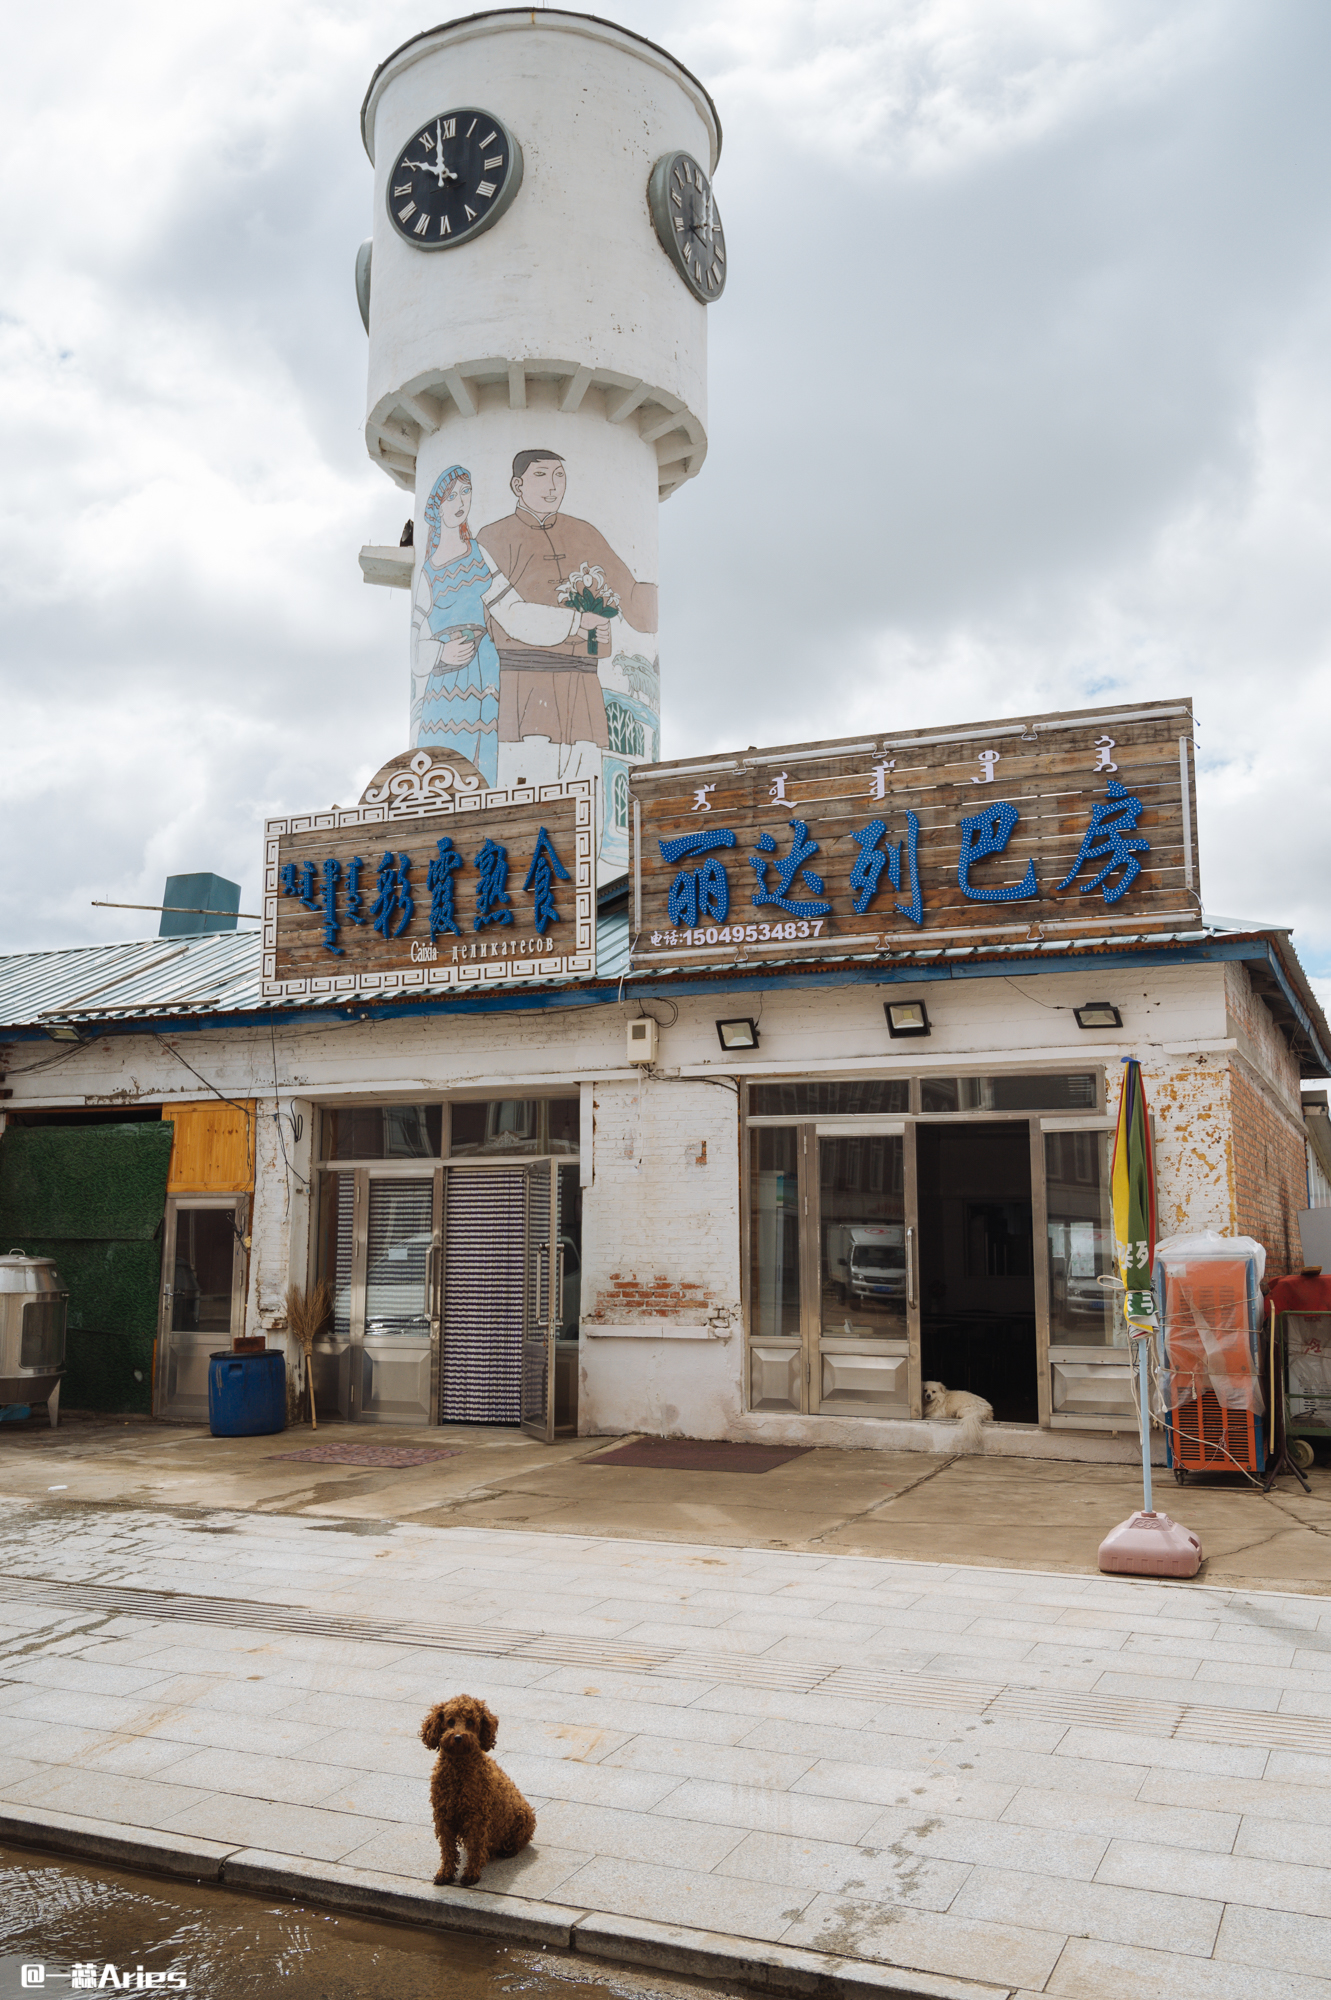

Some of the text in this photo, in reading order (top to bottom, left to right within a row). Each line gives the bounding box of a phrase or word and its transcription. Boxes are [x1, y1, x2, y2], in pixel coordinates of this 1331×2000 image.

[442, 118, 457, 140] XII
[418, 132, 435, 152] XI
[479, 131, 497, 149] II
[484, 154, 503, 171] III
[394, 182, 412, 197] IX
[464, 204, 477, 221] V
[413, 213, 430, 235] VII
[440, 215, 451, 235] VI
[658, 780, 1150, 928] 丽达列巴房
[369, 826, 571, 942] 彩霞熟食
[410, 937, 554, 963] Caixia деликатесов
